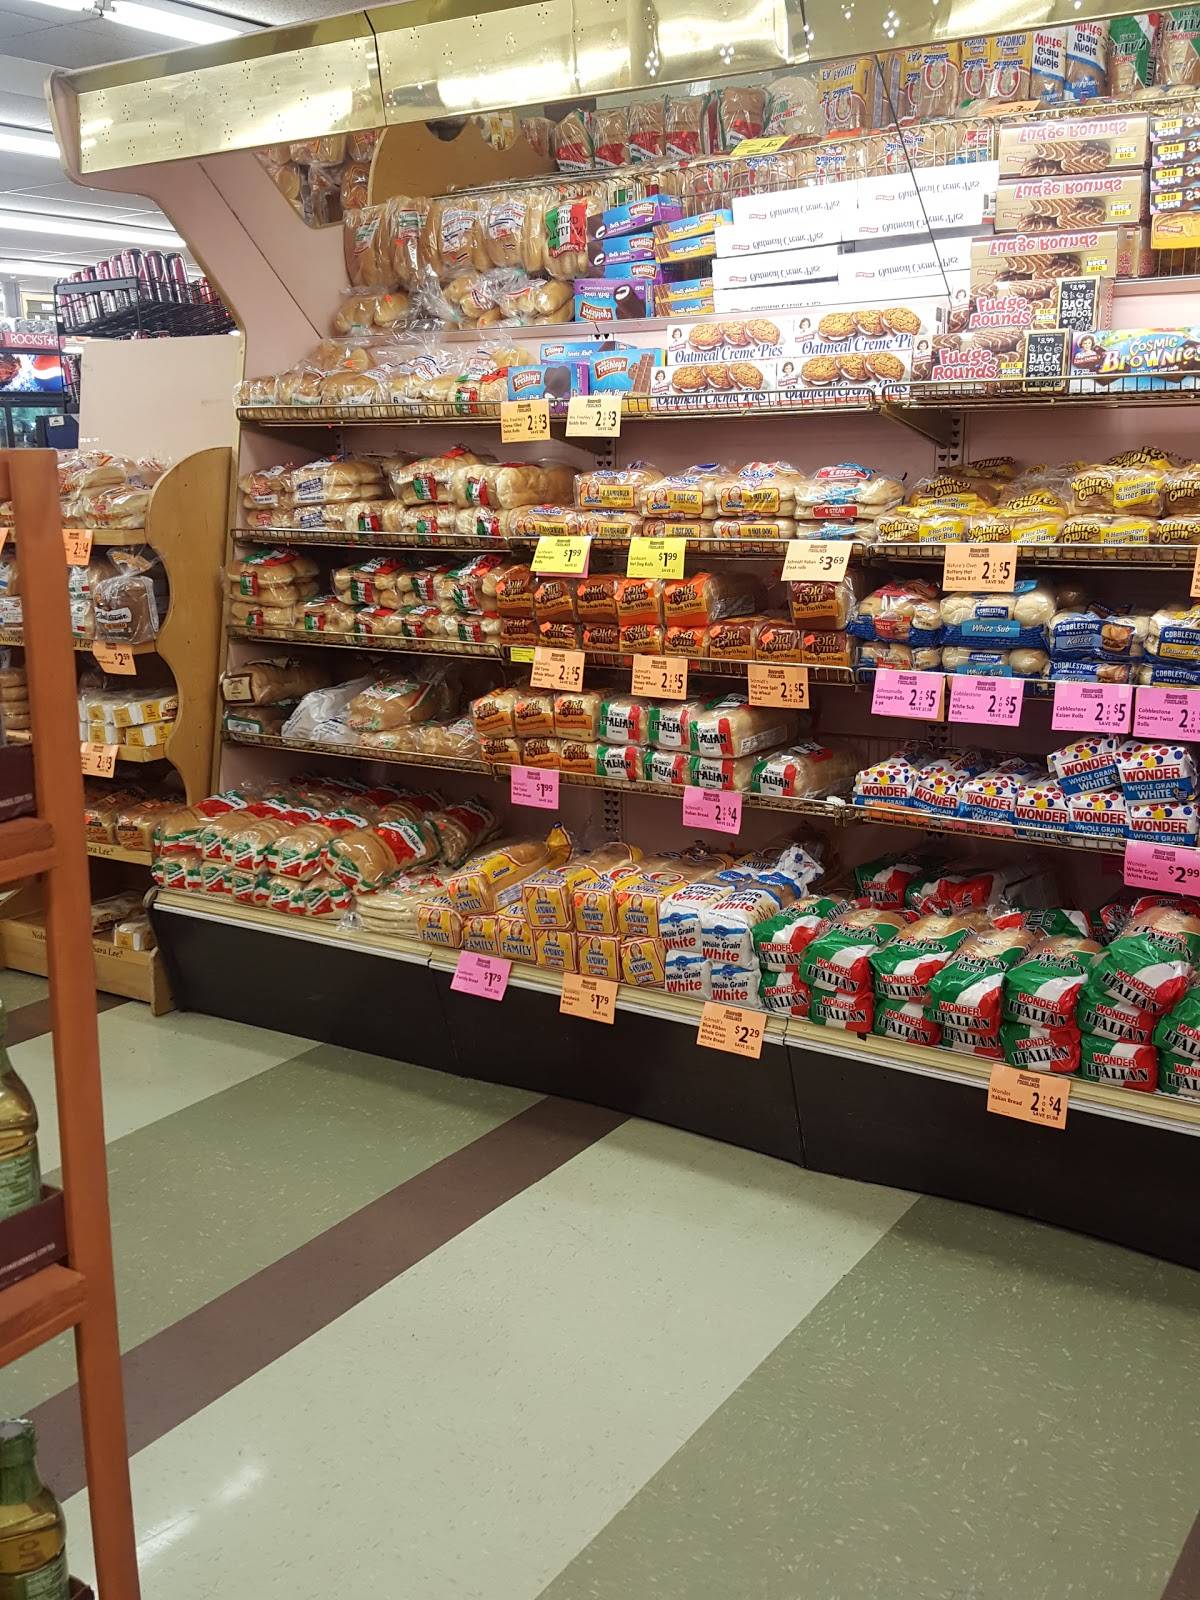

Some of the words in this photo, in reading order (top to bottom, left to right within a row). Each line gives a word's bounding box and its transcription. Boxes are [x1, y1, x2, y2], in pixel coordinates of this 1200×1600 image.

[976, 296, 1028, 313] Fudge
[1062, 299, 1091, 310] BACK
[970, 310, 1031, 329] Rounds
[675, 348, 719, 363] Oatmeal
[721, 347, 756, 360] Creme
[757, 344, 783, 358] Pies
[802, 341, 851, 354] Oatmeal
[854, 339, 892, 352] Creme
[939, 348, 991, 366] Fudge
[1029, 353, 1060, 364] BACK
[932, 363, 997, 380] Rounds
[1028, 363, 1061, 373] SCHOOL
[596, 410, 602, 426] 2
[1078, 486, 1103, 500] Own
[981, 562, 990, 580] 2
[999, 562, 1011, 580] $5
[971, 623, 993, 633] White
[994, 623, 1011, 633] Sub
[1057, 622, 1099, 631] COBBLESTONE
[559, 665, 566, 679] 2
[662, 672, 668, 688] 2
[780, 682, 788, 698] 2
[909, 689, 918, 706] 2
[925, 690, 936, 707] $5
[988, 695, 997, 713] 2
[1005, 696, 1017, 714] $5
[1178, 709, 1188, 728] 2
[1062, 755, 1114, 776] WONDER
[1123, 767, 1180, 781] WONDER
[1078, 778, 1110, 791] WHITE
[1128, 784, 1153, 792] WHOLE
[1155, 782, 1179, 791] GRAIN
[1137, 789, 1171, 799] WHITE
[715, 805, 721, 821] 2
[1016, 808, 1067, 822] WONDER
[1073, 811, 1125, 824] WONDER
[1131, 819, 1188, 833] WONDER
[1168, 865, 1199, 883] $299
[422, 931, 450, 943] FAMILY
[663, 936, 696, 950] White
[502, 943, 532, 956] FAMILY
[703, 941, 720, 949] Whole
[722, 941, 741, 950] Grain
[760, 943, 792, 952] WONDER
[703, 948, 739, 961] White
[816, 957, 851, 978] WONDER
[667, 979, 703, 992] White
[808, 964, 859, 992] ITALIAN
[881, 974, 918, 984] WONDER
[1115, 969, 1156, 998] WONDER
[712, 990, 748, 1001] White
[765, 985, 796, 996] WONDER
[1103, 971, 1161, 1012] ITALIAN
[821, 997, 855, 1010] WONDER
[939, 1001, 981, 1016] WONDER
[1018, 992, 1059, 1012] WONDER
[816, 1005, 866, 1022] ITALIAN
[886, 1009, 922, 1028] WONDER
[934, 1010, 990, 1029] ITALIAN
[1009, 1001, 1066, 1027] ITALIAN
[1096, 1004, 1138, 1026] WONDER
[735, 1026, 760, 1043] $229
[1085, 1011, 1147, 1043] ITALIAN
[1016, 1037, 1055, 1049] WONDER
[1093, 1053, 1136, 1067] WONDER
[1087, 1063, 1148, 1081] ITALIAN
